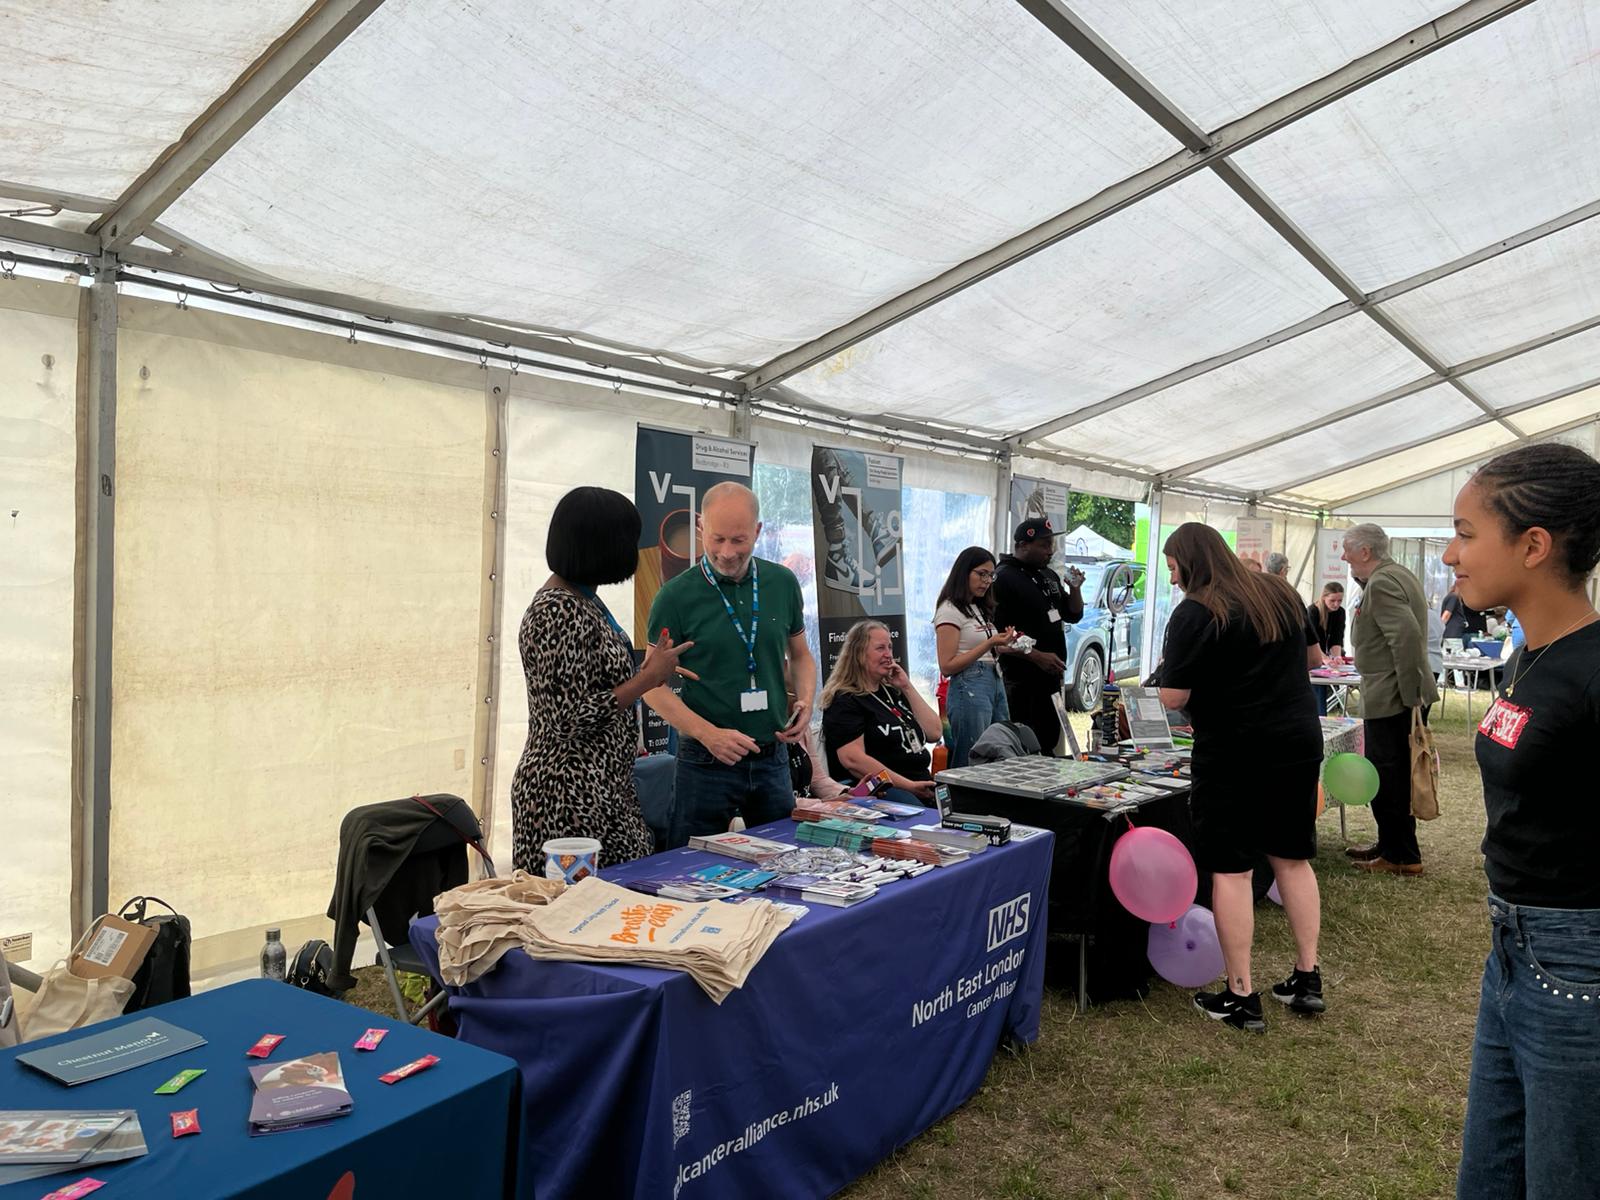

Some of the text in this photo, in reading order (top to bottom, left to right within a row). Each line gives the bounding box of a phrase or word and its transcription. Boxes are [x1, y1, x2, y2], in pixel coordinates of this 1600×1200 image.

[695, 443, 708, 453] Drug
[712, 446, 729, 455] Alcohol
[730, 449, 748, 457] Services
[989, 897, 1029, 948] NHS
[912, 948, 1026, 1028] North East London
[57, 1049, 113, 1067] Chestnut
[114, 1036, 153, 1052] Manor
